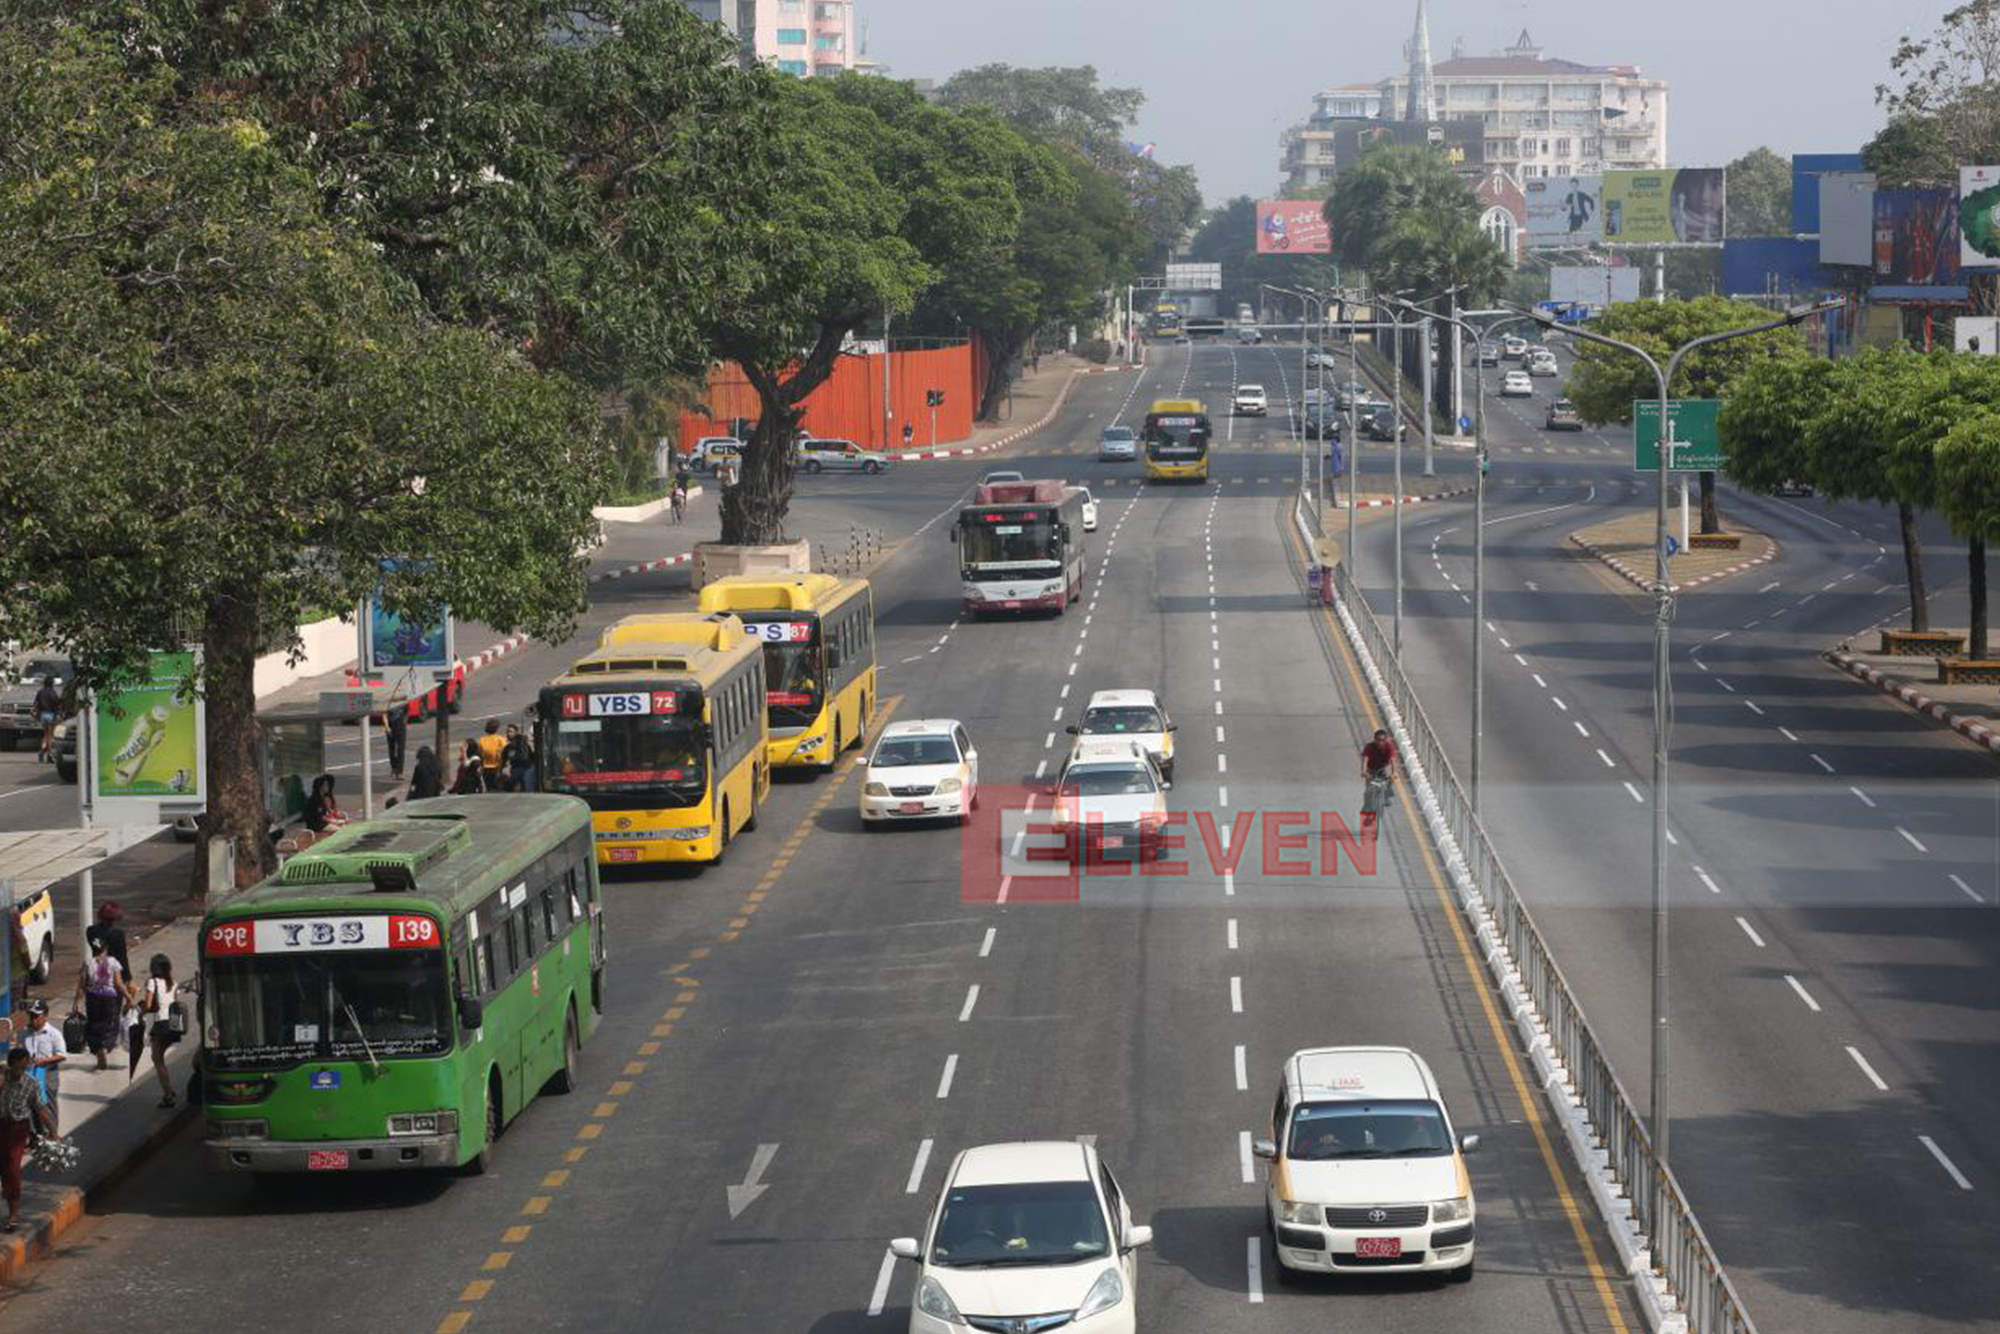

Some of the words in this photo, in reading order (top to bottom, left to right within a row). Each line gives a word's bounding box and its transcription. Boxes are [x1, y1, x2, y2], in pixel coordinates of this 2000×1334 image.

[791, 625, 809, 637] 87
[597, 696, 642, 713] YBS
[655, 696, 674, 709] 72
[279, 921, 365, 946] YBS
[397, 920, 432, 943] 139
